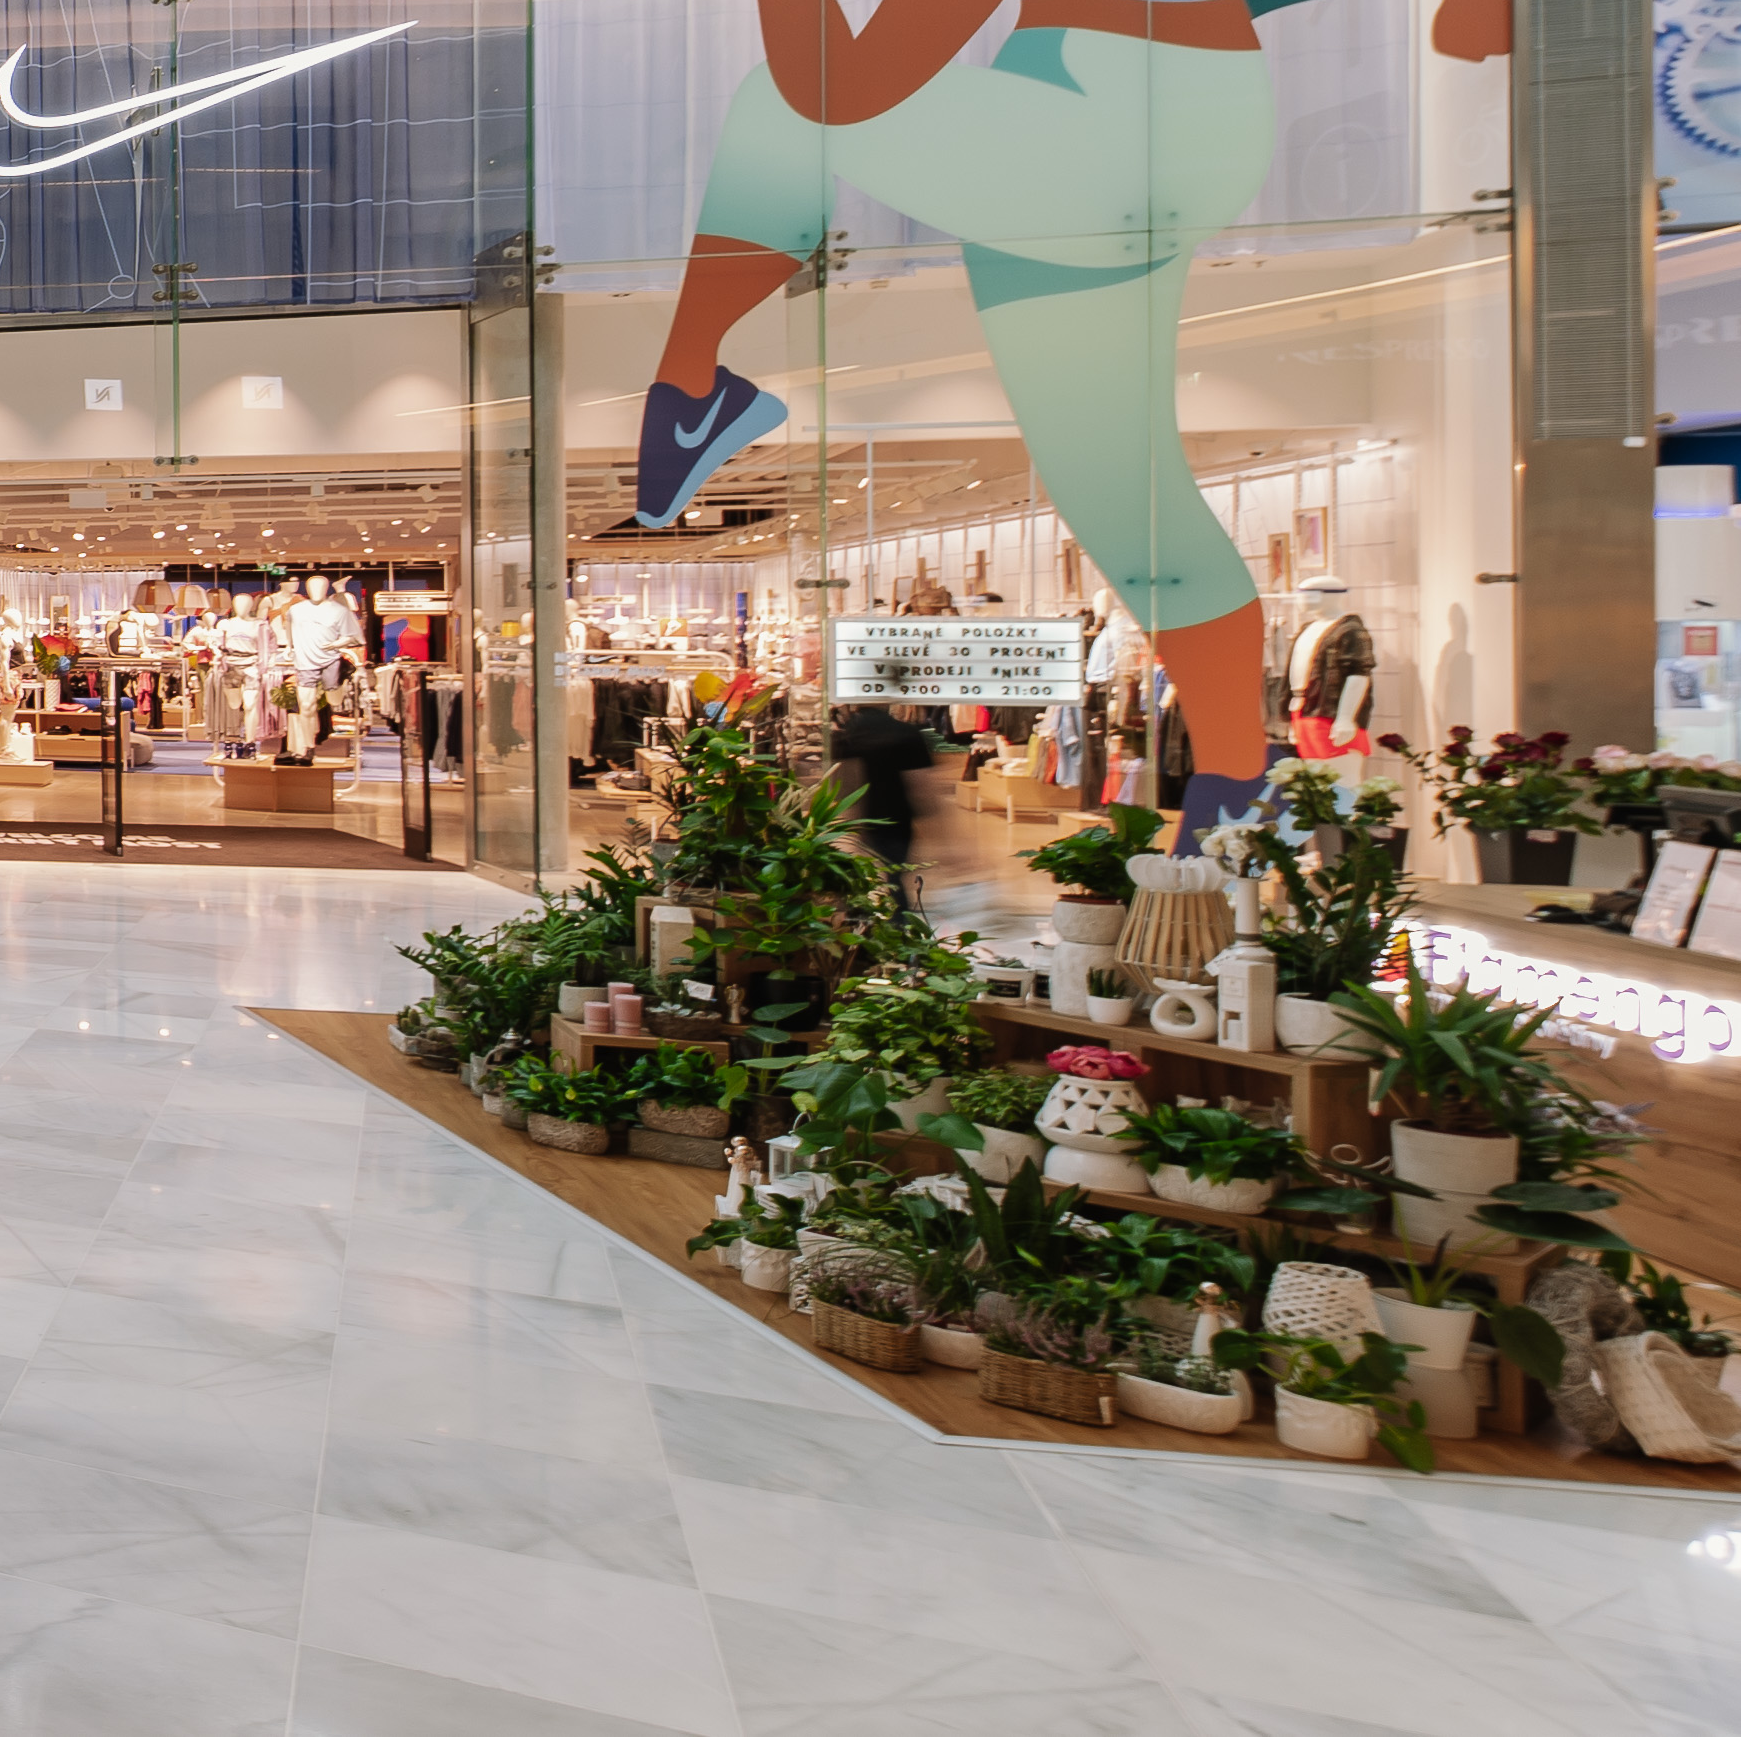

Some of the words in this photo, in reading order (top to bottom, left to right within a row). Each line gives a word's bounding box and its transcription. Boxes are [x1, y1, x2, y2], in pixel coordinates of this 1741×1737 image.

[866, 626, 943, 640] VYBRANÉ
[961, 625, 1038, 638] POLOŽKY
[847, 646, 866, 656] VE
[883, 644, 930, 657] SLEVÉ
[989, 646, 1067, 660] PROCENT
[874, 664, 884, 675] V
[900, 665, 972, 676] PRODEJI
[991, 665, 1042, 678] #NIKE
[861, 683, 884, 693] OD
[899, 684, 941, 695] 9:00
[959, 684, 982, 695] DO
[1001, 685, 1053, 696] 21:00
